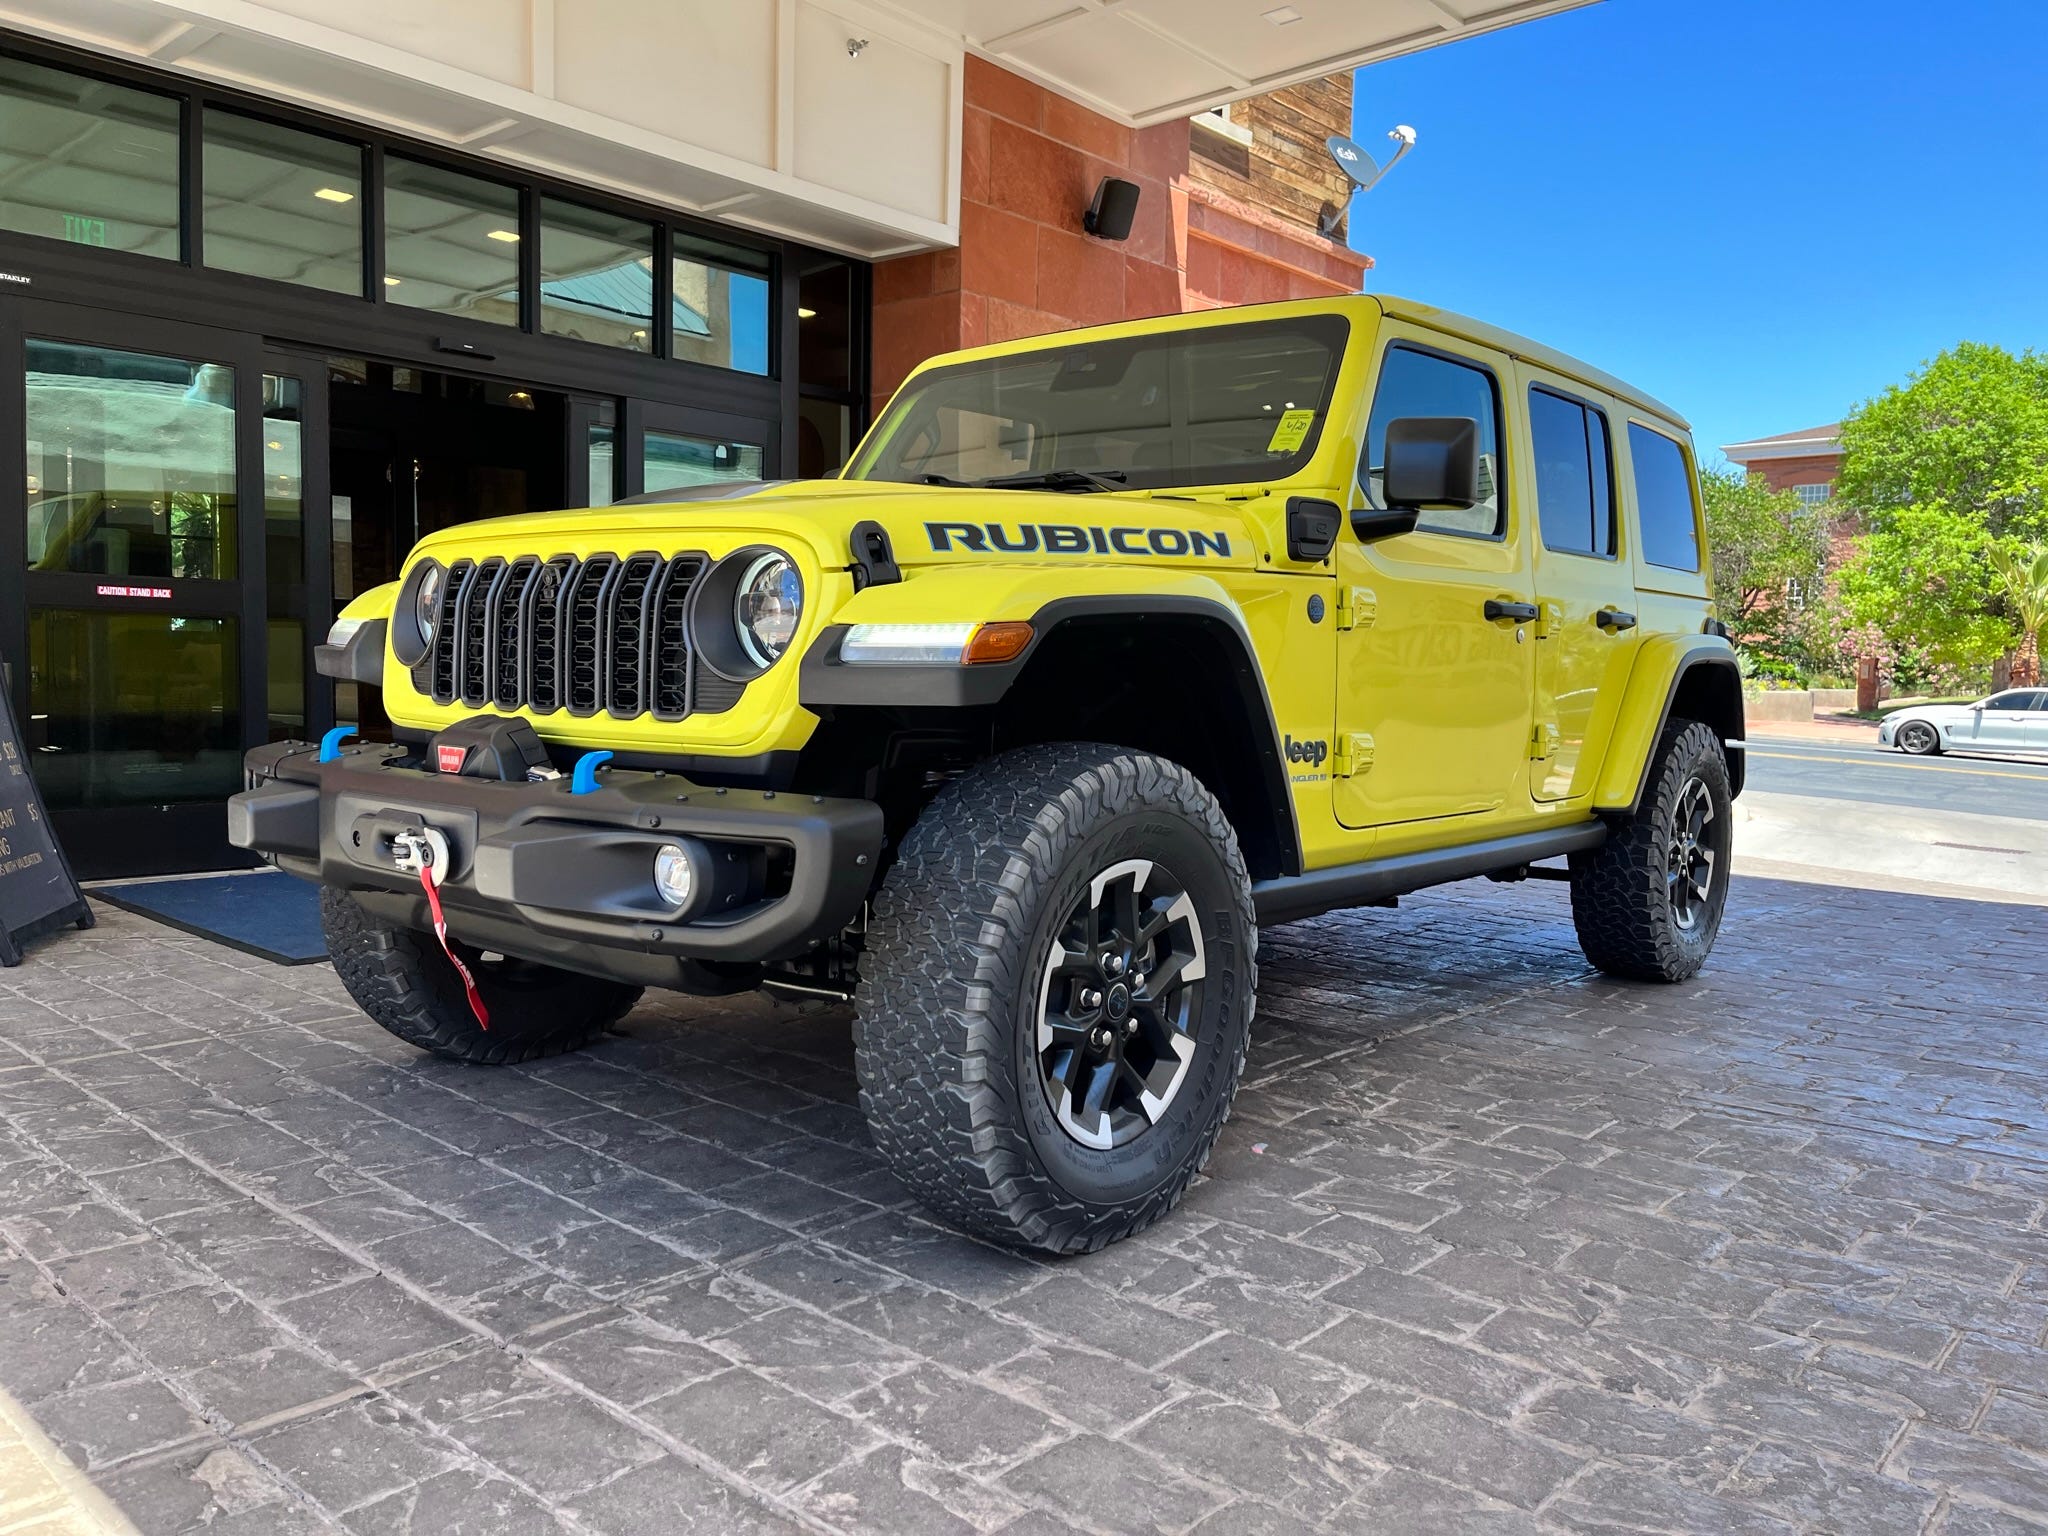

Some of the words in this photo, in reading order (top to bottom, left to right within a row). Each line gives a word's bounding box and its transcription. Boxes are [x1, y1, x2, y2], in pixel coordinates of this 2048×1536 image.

[923, 522, 1232, 557] RUBICON
[98, 586, 127, 596] CAUTION
[129, 587, 151, 597] STAND
[153, 588, 172, 598] BACK
[1285, 734, 1327, 767] Jeep
